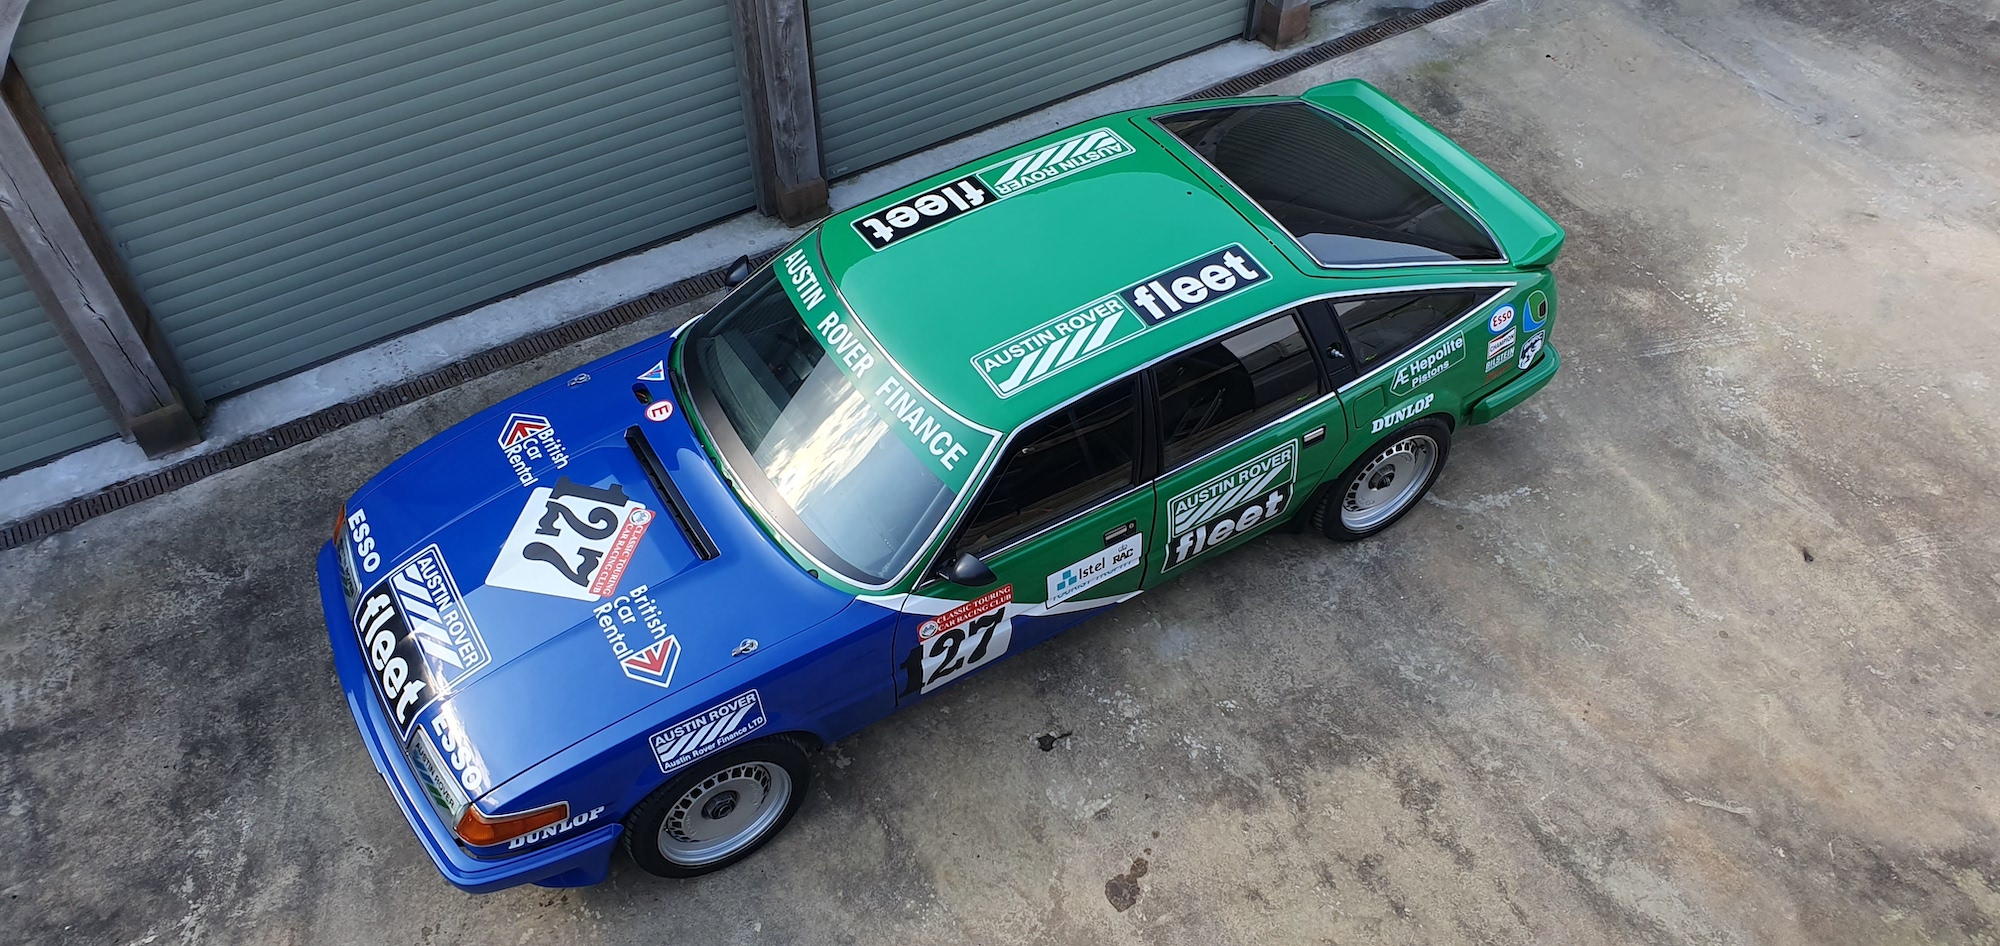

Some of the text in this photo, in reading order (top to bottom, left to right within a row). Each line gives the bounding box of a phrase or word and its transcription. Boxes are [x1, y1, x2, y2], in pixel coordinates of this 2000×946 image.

[994, 142, 1124, 196] AUSTIN ROVER
[862, 180, 986, 243] fleet
[1133, 251, 1259, 320] fleet
[983, 299, 1125, 373] AUSTIN ROVER
[1489, 334, 1515, 353] CHAMPION
[1492, 310, 1512, 327] ESSO
[783, 248, 969, 471] AUSTIN ROVER FINANCE
[1410, 336, 1464, 377] Hepolite
[1411, 360, 1450, 388] Pistons
[1485, 346, 1516, 371] BILSTEIN
[651, 404, 669, 418] E
[1371, 393, 1435, 434] DUNLOP
[503, 444, 539, 487] Rental
[522, 438, 543, 460] Car
[537, 428, 570, 470] British
[1175, 448, 1292, 515] AUSTIN ROVER
[348, 508, 381, 573] ESSO
[522, 475, 630, 588] 127
[1175, 490, 1284, 564] fleet
[593, 523, 634, 594] CAR RACING CLUB
[602, 525, 644, 596] CLASSIC TOURING
[1079, 548, 1134, 580] Istel RAC
[417, 556, 480, 668] AUSTIN ROVER
[592, 602, 635, 660] Rental
[613, 596, 637, 625] Car
[629, 584, 668, 640] British
[936, 585, 1011, 624] CLASSIC TOURING
[938, 594, 1012, 632] CAR RACING CLUB
[359, 593, 427, 725] fleet
[898, 606, 1006, 699] 127
[655, 693, 757, 747] AUSTIN ROVER
[664, 716, 764, 770] Austin Rover Finance LTD
[415, 742, 455, 808] AUSTIN ROVER
[431, 713, 483, 791] ESSO
[508, 805, 605, 849] DUNLOP
